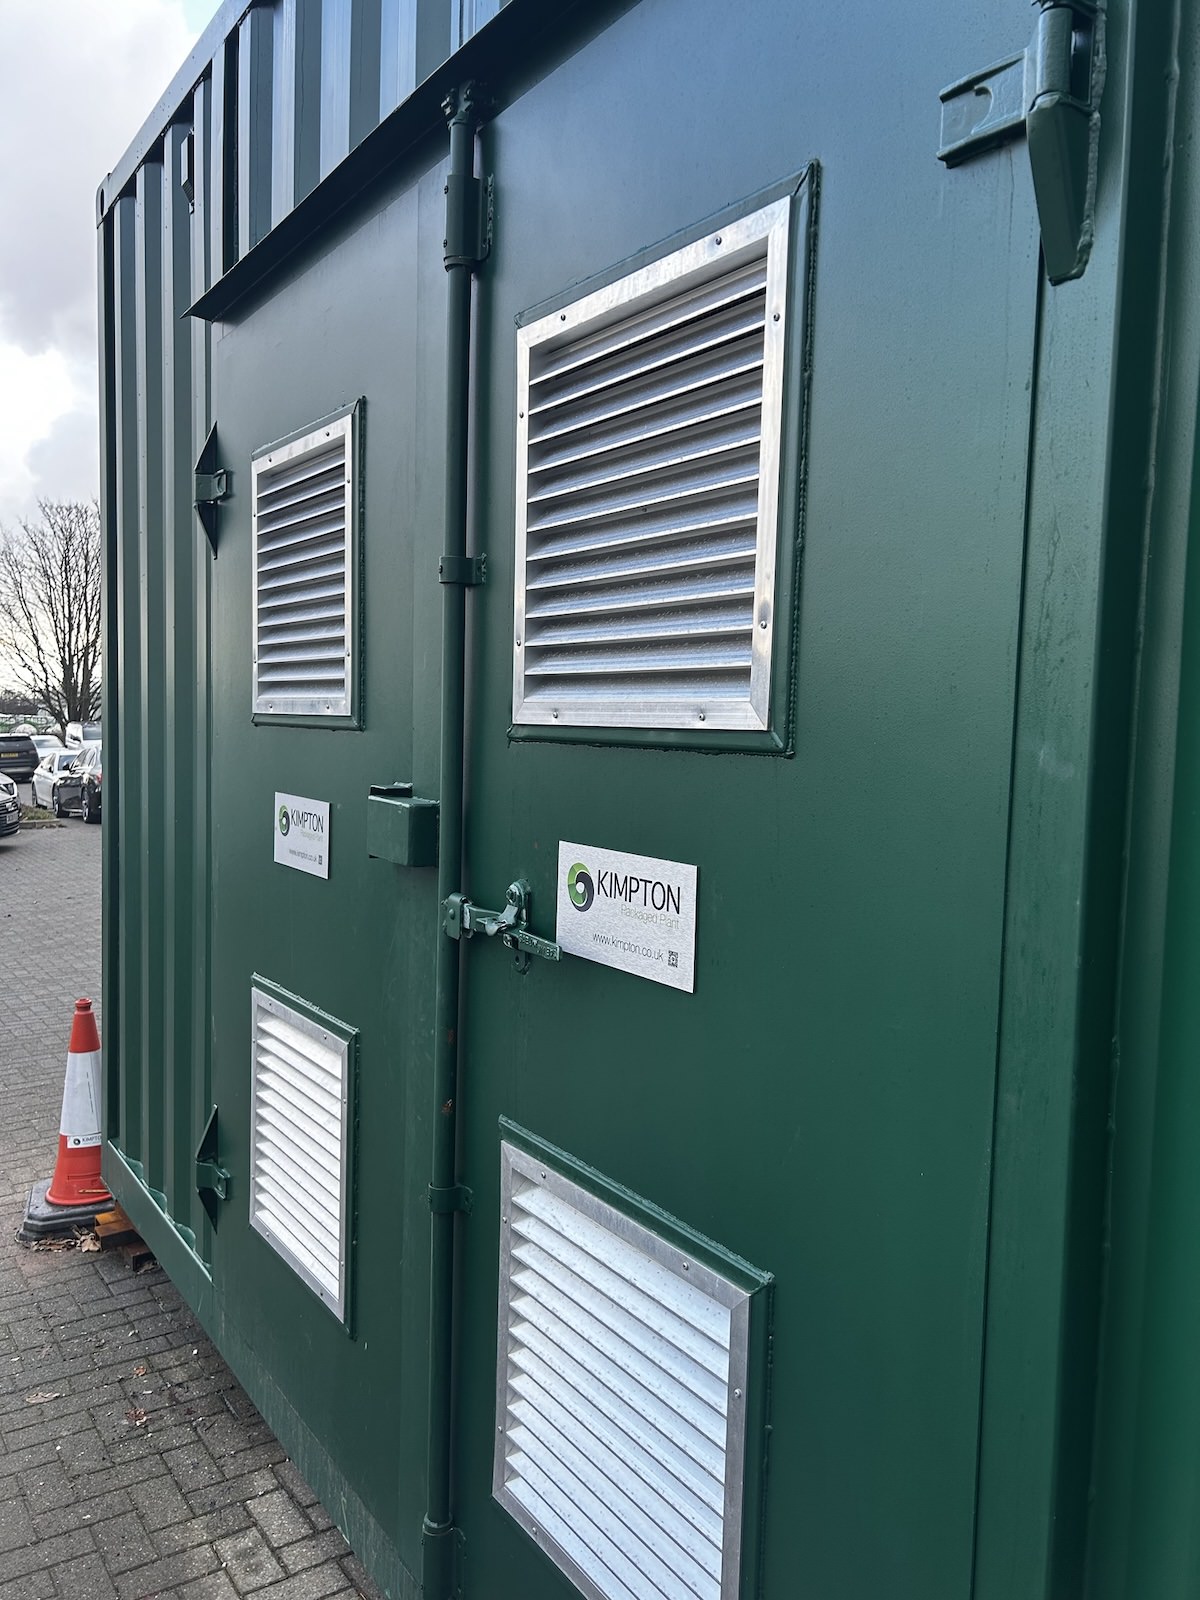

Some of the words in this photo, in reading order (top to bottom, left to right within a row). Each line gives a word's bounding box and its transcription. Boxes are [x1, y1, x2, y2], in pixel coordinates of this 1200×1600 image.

[290, 808, 324, 833] KIMPTON
[597, 869, 681, 915] KIMPTON
[620, 904, 658, 925] Packaged
[659, 913, 680, 930] Plant
[592, 933, 664, 962] www.kimpton.co.uk
